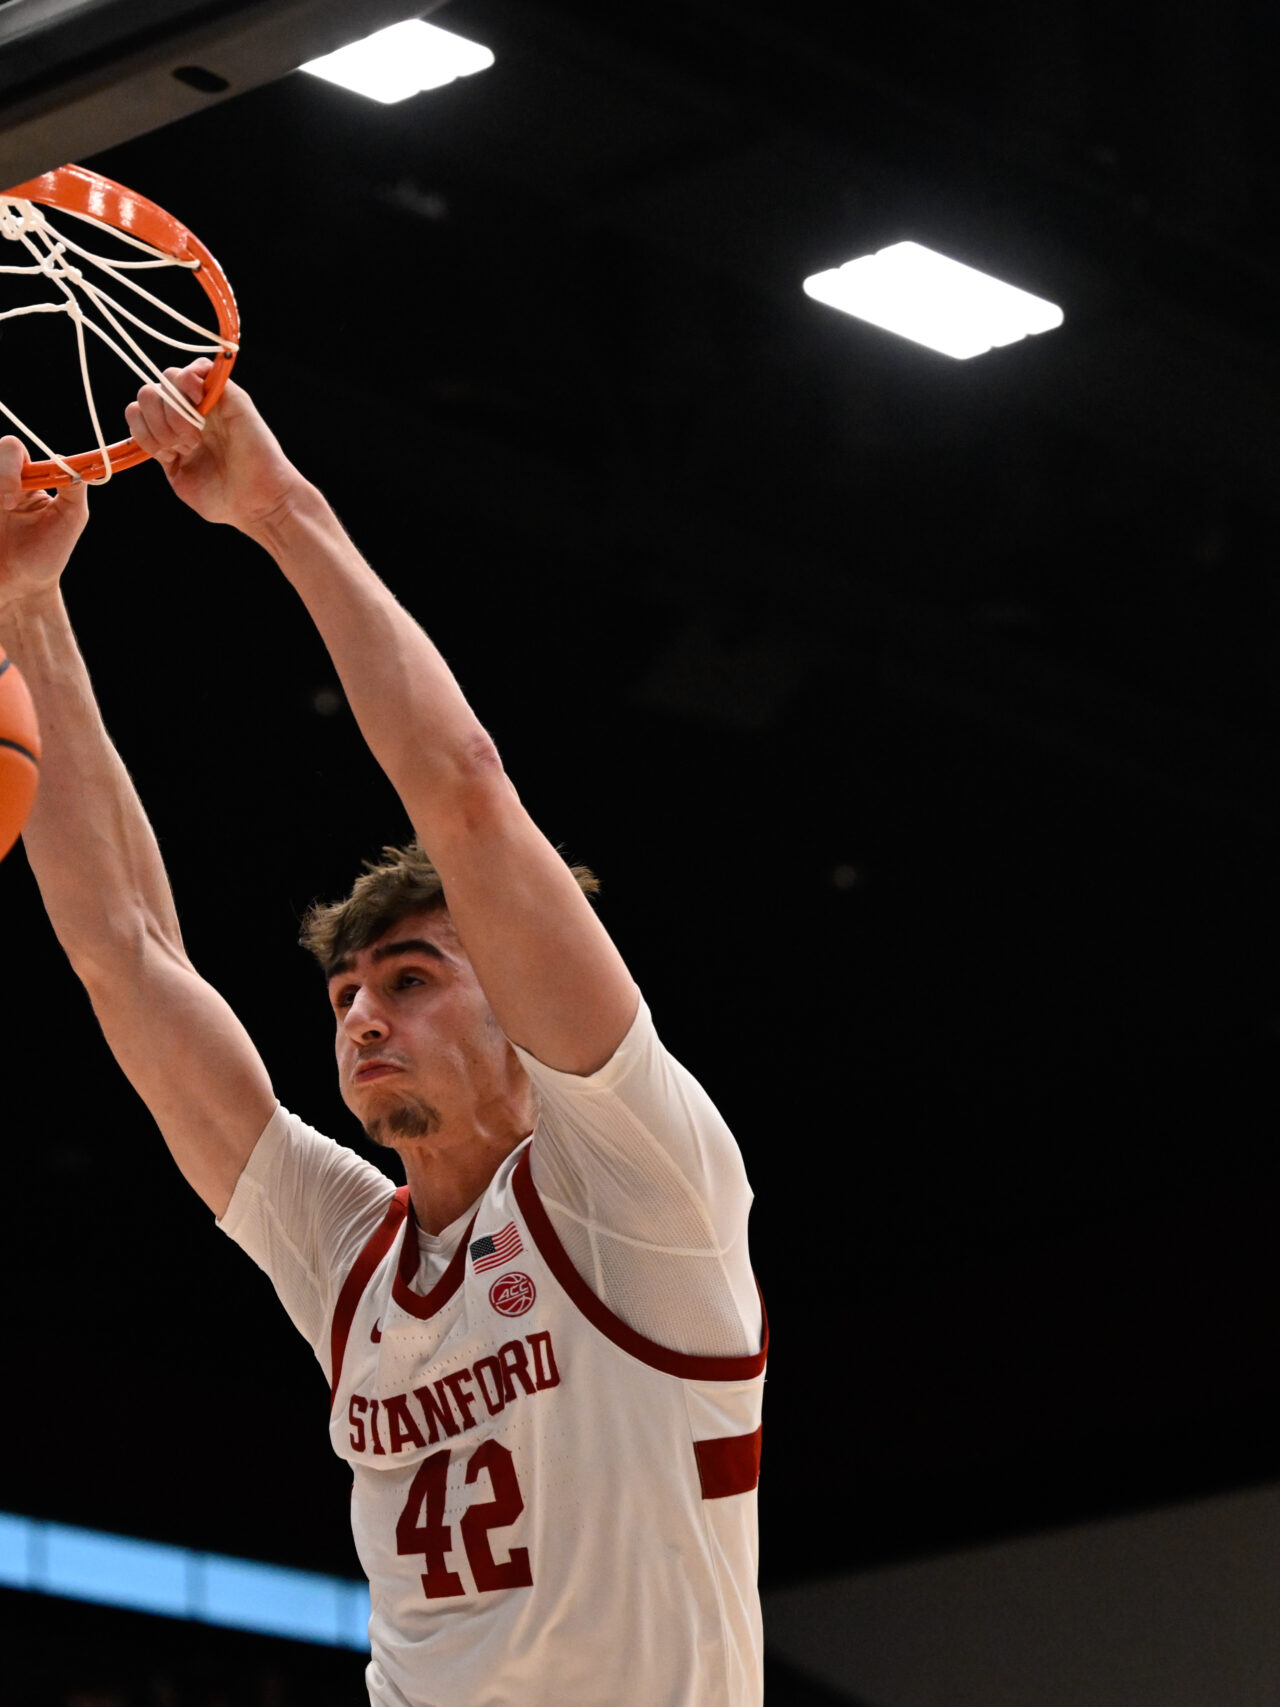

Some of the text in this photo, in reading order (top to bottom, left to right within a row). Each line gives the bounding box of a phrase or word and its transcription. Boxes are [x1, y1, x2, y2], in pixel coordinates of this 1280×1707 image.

[497, 1279, 529, 1302] ACC
[348, 1330, 561, 1456] STANFORD
[395, 1438, 534, 1599] 42
